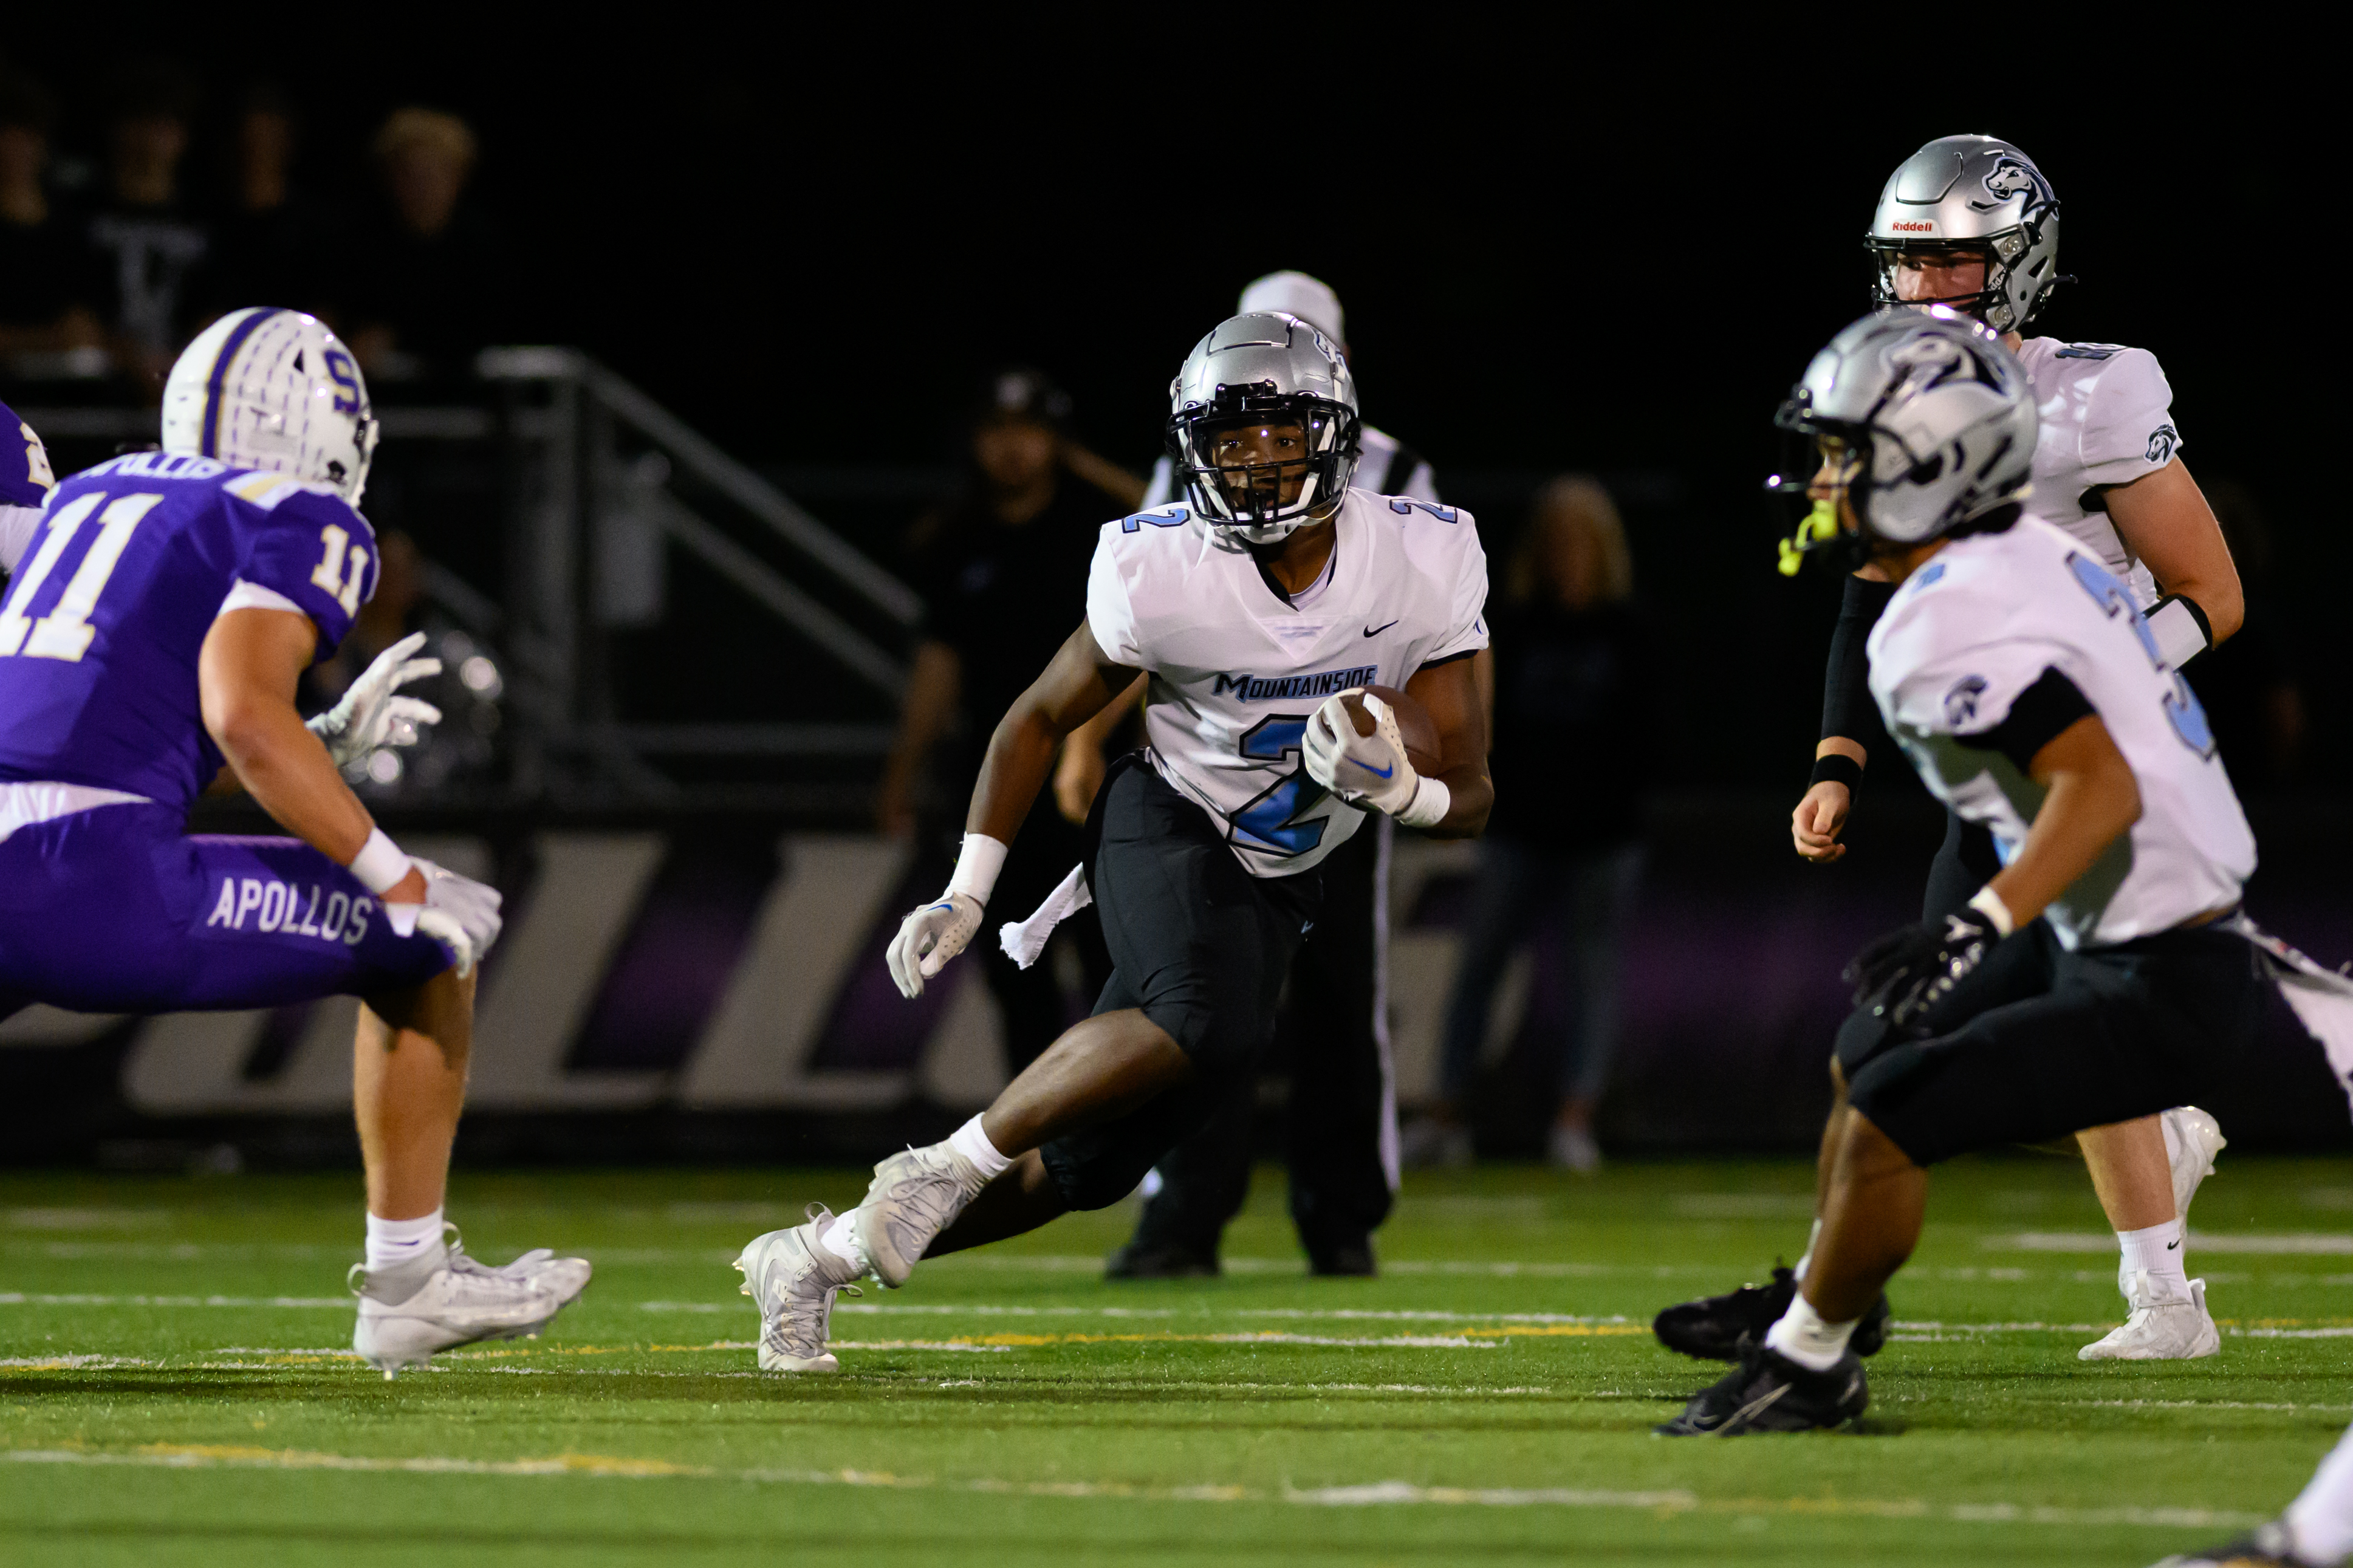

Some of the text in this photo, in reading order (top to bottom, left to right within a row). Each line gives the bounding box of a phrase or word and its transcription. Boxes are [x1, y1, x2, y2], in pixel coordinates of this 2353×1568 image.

[1892, 221, 1932, 231] Riddell
[324, 349, 360, 414] S
[1122, 507, 1190, 533] 2
[1389, 499, 1458, 524] 2
[0, 491, 164, 662] 11
[311, 524, 369, 620] 11
[1227, 713, 1331, 857] 2
[208, 877, 373, 946] APOLLOS
